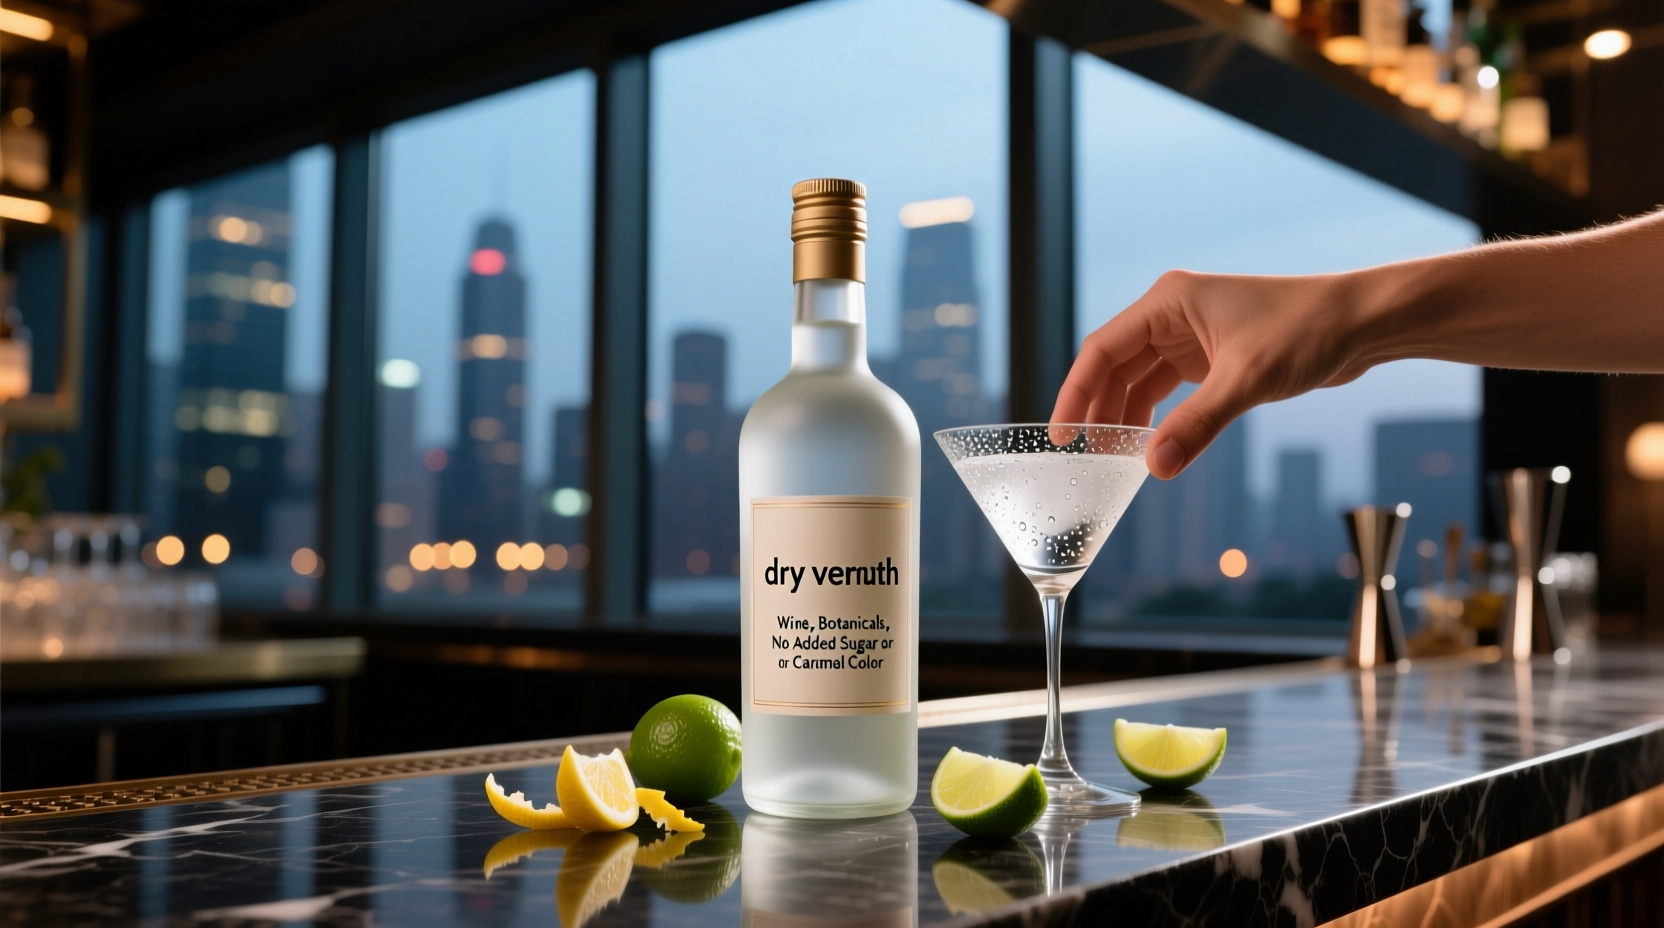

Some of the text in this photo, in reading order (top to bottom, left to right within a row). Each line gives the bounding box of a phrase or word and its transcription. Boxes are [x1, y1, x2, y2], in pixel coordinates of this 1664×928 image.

[764, 556, 806, 594] dry
[777, 614, 891, 633] Wine, Botanicals,
[772, 634, 895, 655] No Added Sugar or
[778, 658, 790, 669] or
[847, 654, 885, 670] Color
